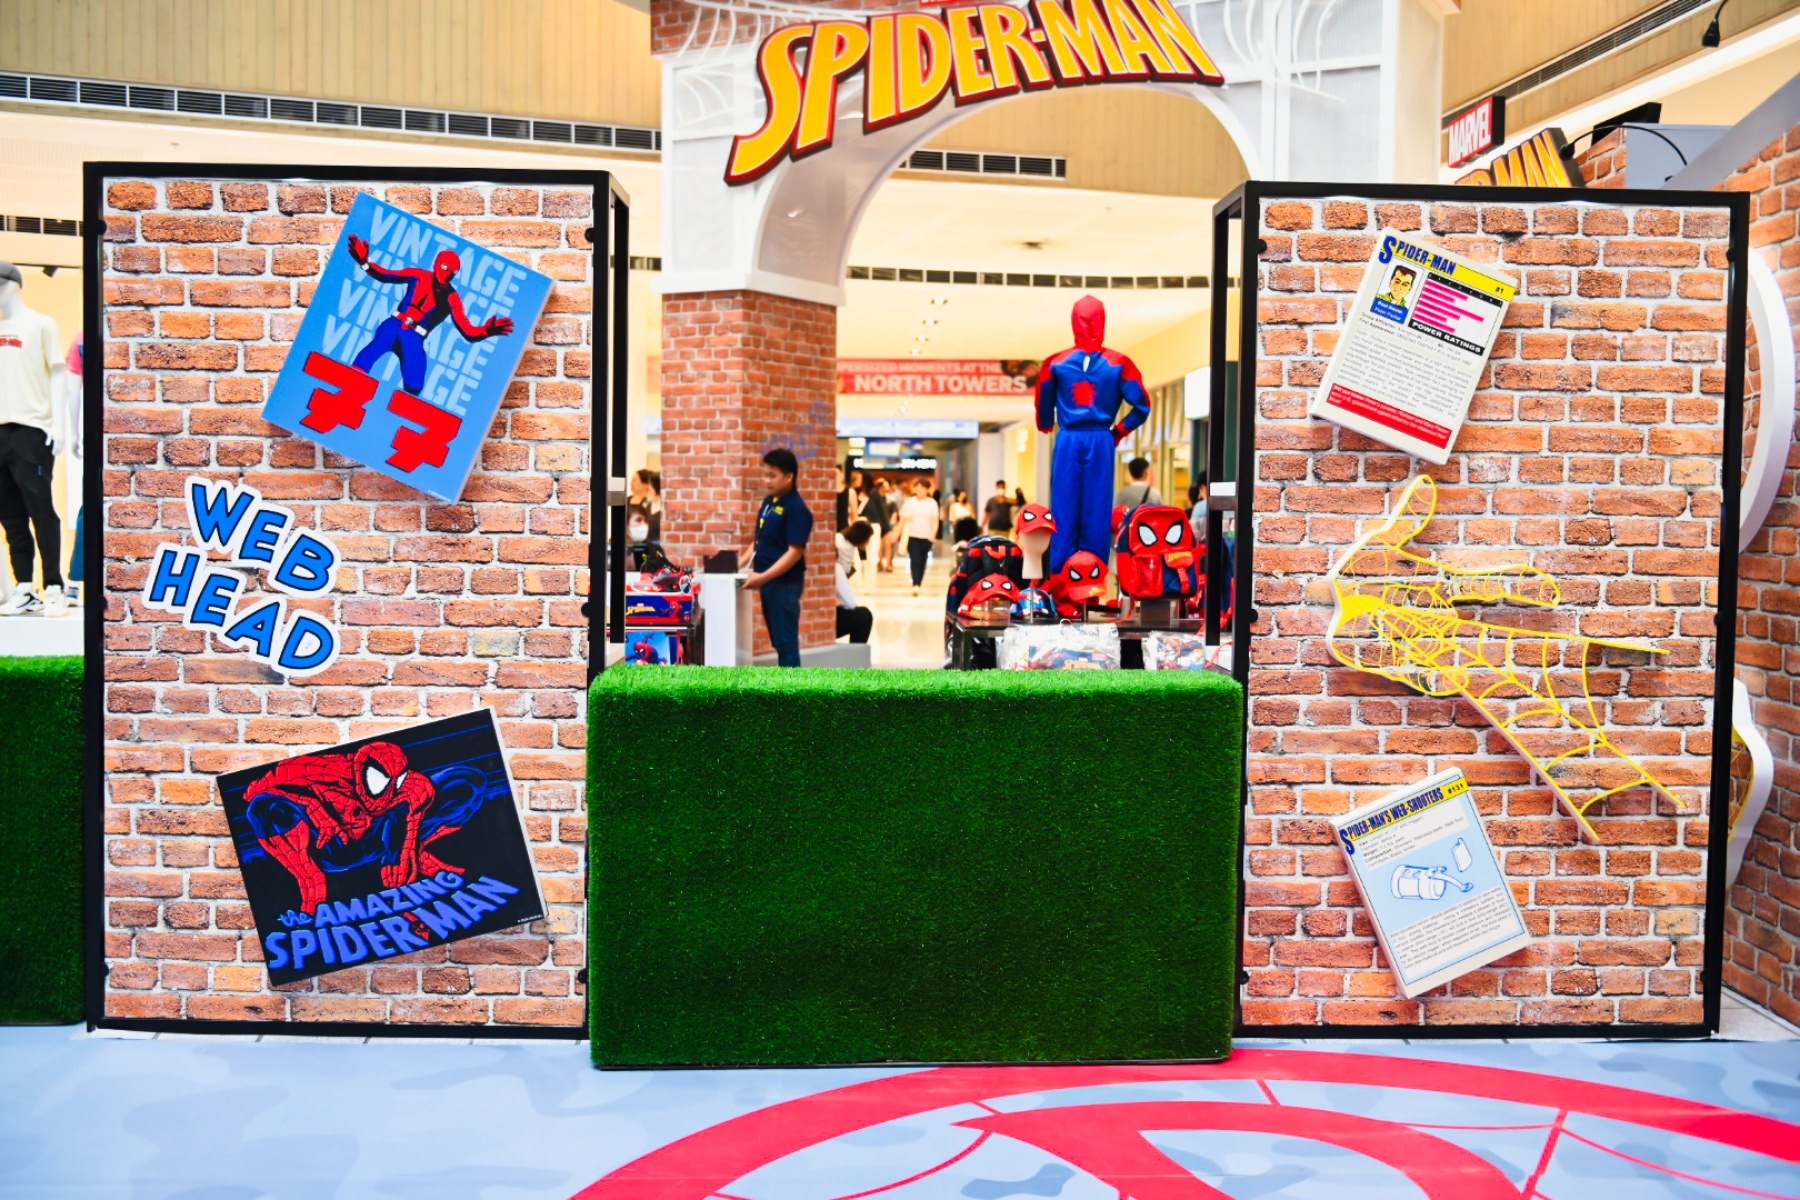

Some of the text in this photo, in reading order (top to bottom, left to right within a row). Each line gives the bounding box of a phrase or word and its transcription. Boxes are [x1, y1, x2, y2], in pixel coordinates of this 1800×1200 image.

[727, 0, 1222, 183] SPIDER-MAN
[1449, 101, 1492, 166] MARVEL
[1378, 235, 1457, 276] SPIDER-MAN
[1412, 322, 1482, 354] POWER RATINGS
[855, 374, 1028, 393] NORTH TOWERS
[191, 482, 335, 592] WEB
[148, 548, 335, 670] HEAD
[1338, 809, 1393, 856] SPIDER-MAN'S
[1389, 787, 1445, 821] WEB-SHOOTERS
[1447, 783, 1465, 795] #131
[277, 870, 466, 929] the AMAZING
